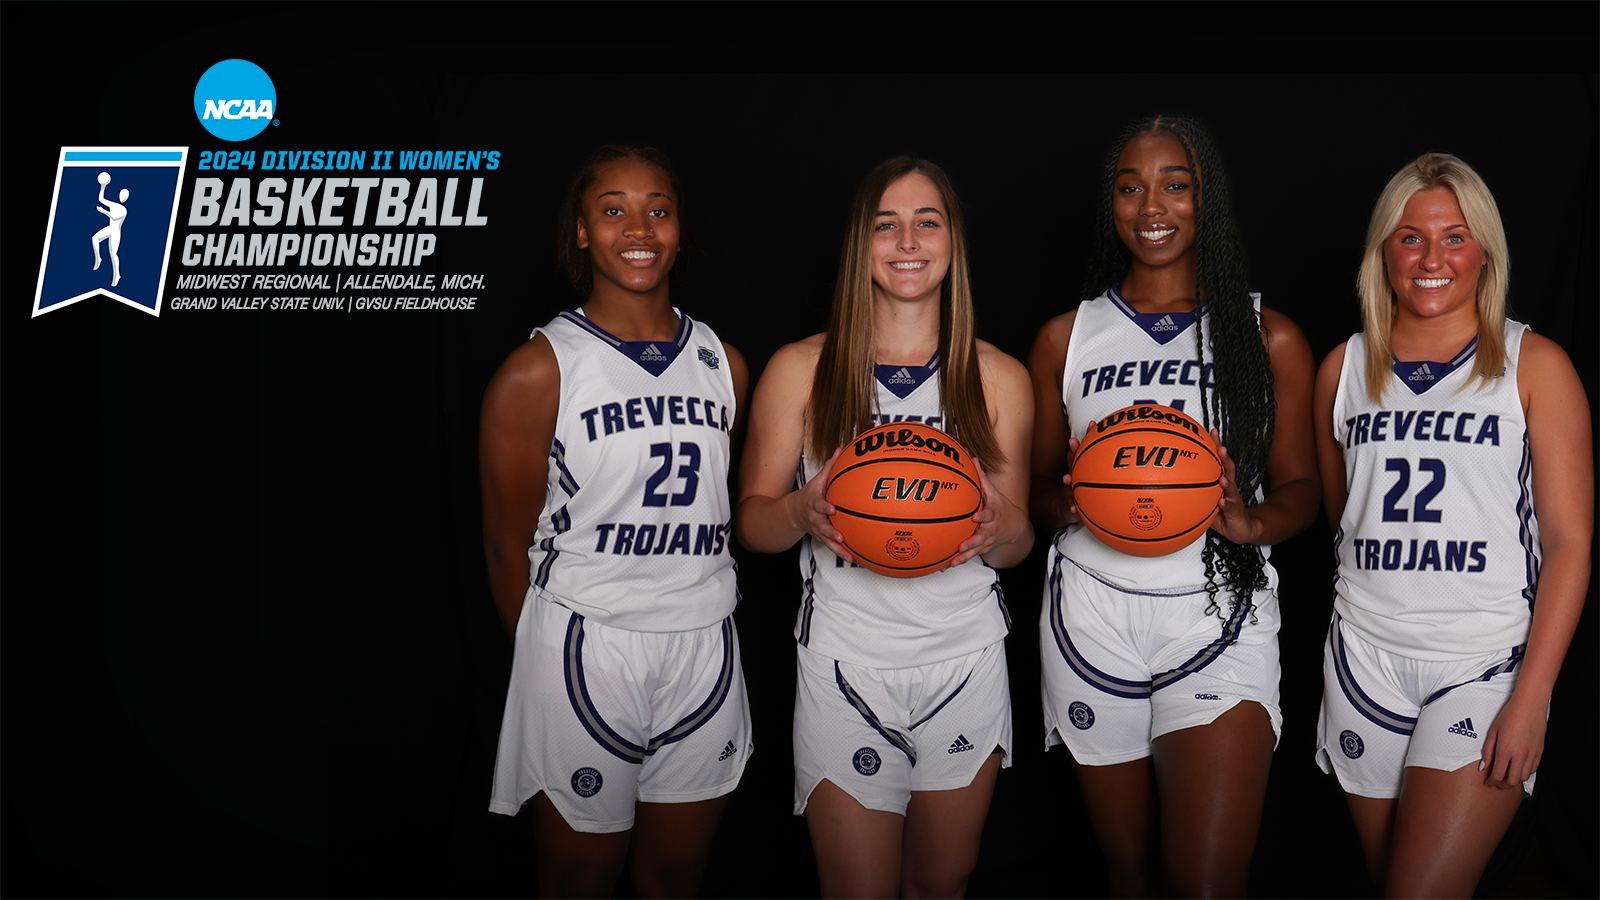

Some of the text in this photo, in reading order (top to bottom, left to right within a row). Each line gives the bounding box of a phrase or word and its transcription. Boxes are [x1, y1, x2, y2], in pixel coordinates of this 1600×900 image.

[1151, 324, 1178, 332] adidas
[888, 377, 915, 385] adidas
[1408, 373, 1434, 381] adidas
[580, 395, 730, 442] TREVECCA
[1097, 406, 1200, 437] Wilson
[1345, 410, 1500, 450] TREVECCA
[854, 429, 961, 464] Wilson
[1113, 446, 1199, 469] EVO NXT
[642, 442, 701, 508] 23
[871, 477, 959, 502] EVO NXT
[1382, 458, 1446, 523] 22
[595, 523, 726, 556] TROJANS
[1353, 538, 1488, 573] TROJANS
[1448, 725, 1478, 739] adidas
[948, 743, 975, 754] adidas
